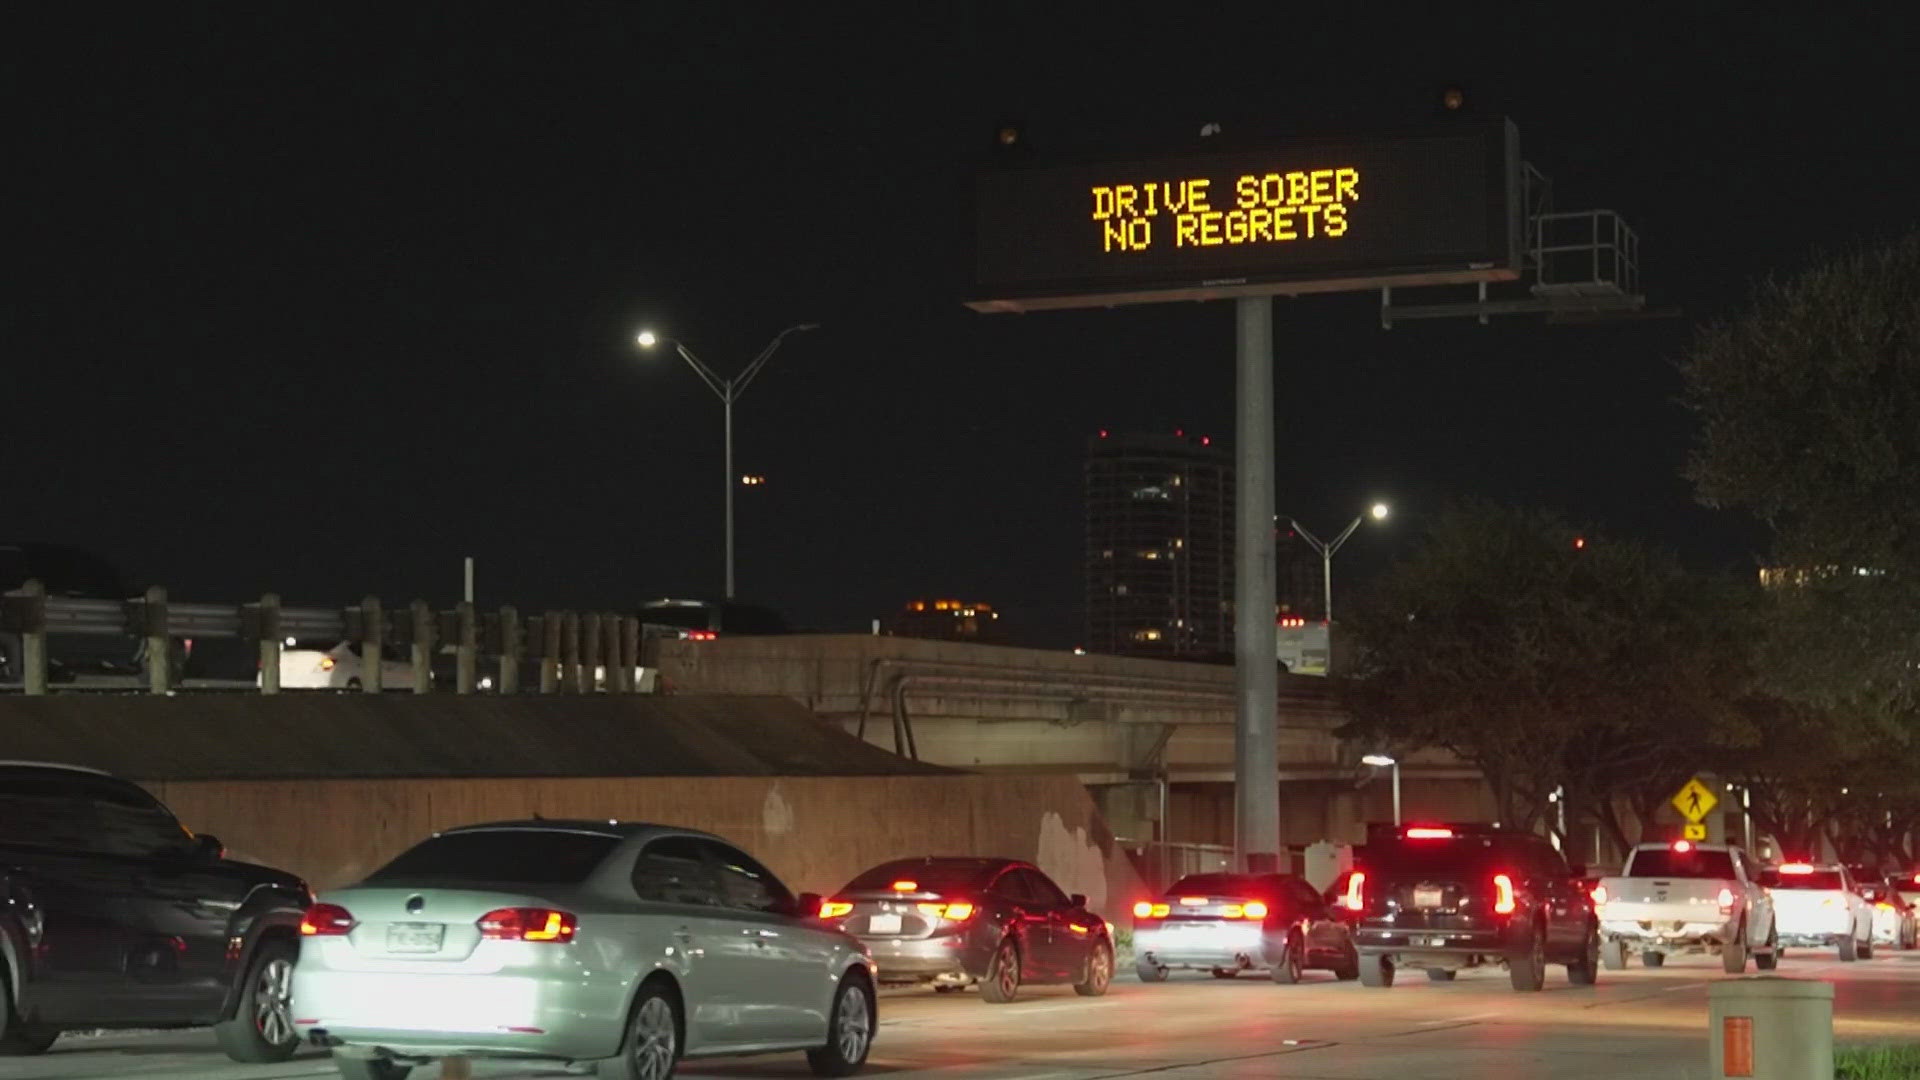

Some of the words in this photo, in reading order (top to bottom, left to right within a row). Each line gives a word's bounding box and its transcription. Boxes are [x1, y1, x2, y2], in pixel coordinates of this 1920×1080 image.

[1092, 179, 1210, 220] DRIVE
[1236, 168, 1359, 209] SOBER
[1104, 217, 1151, 252] NO
[1176, 203, 1347, 248] REGRETS
